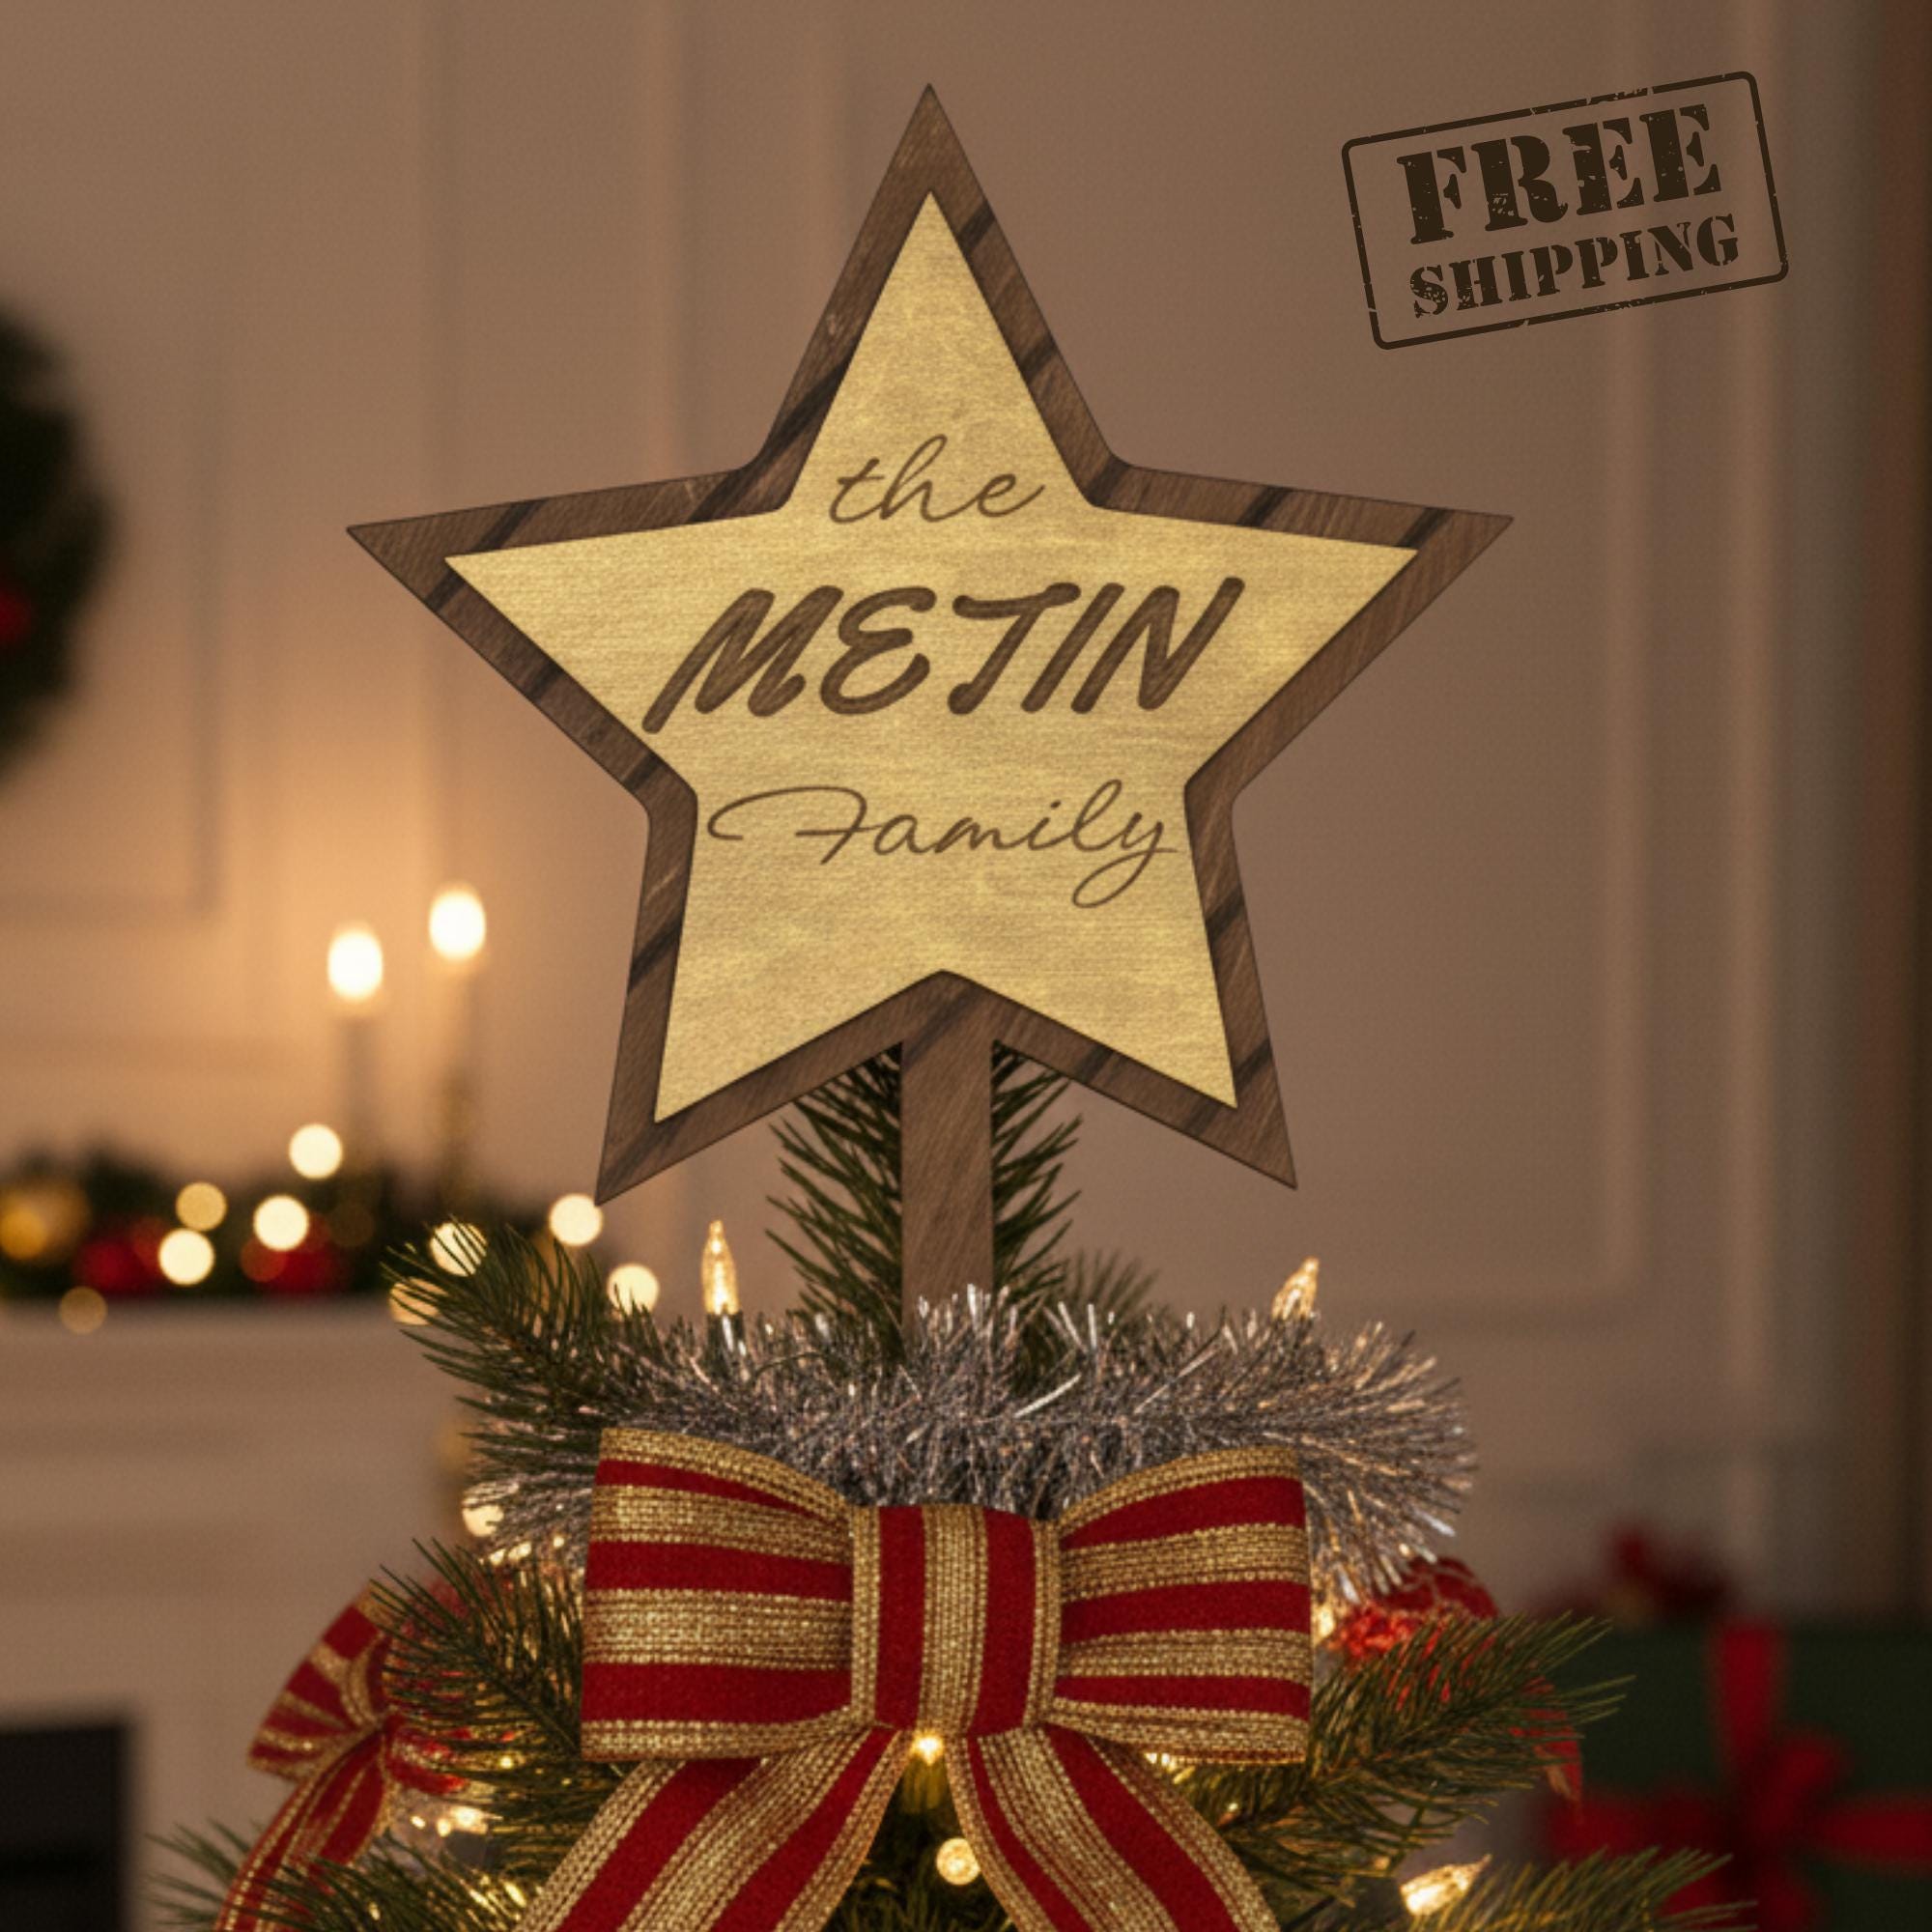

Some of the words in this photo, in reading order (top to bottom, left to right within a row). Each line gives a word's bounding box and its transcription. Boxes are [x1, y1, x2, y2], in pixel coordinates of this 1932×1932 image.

[829, 435, 1045, 524] the
[641, 577, 1245, 733] METIN
[706, 780, 1178, 908] Family
